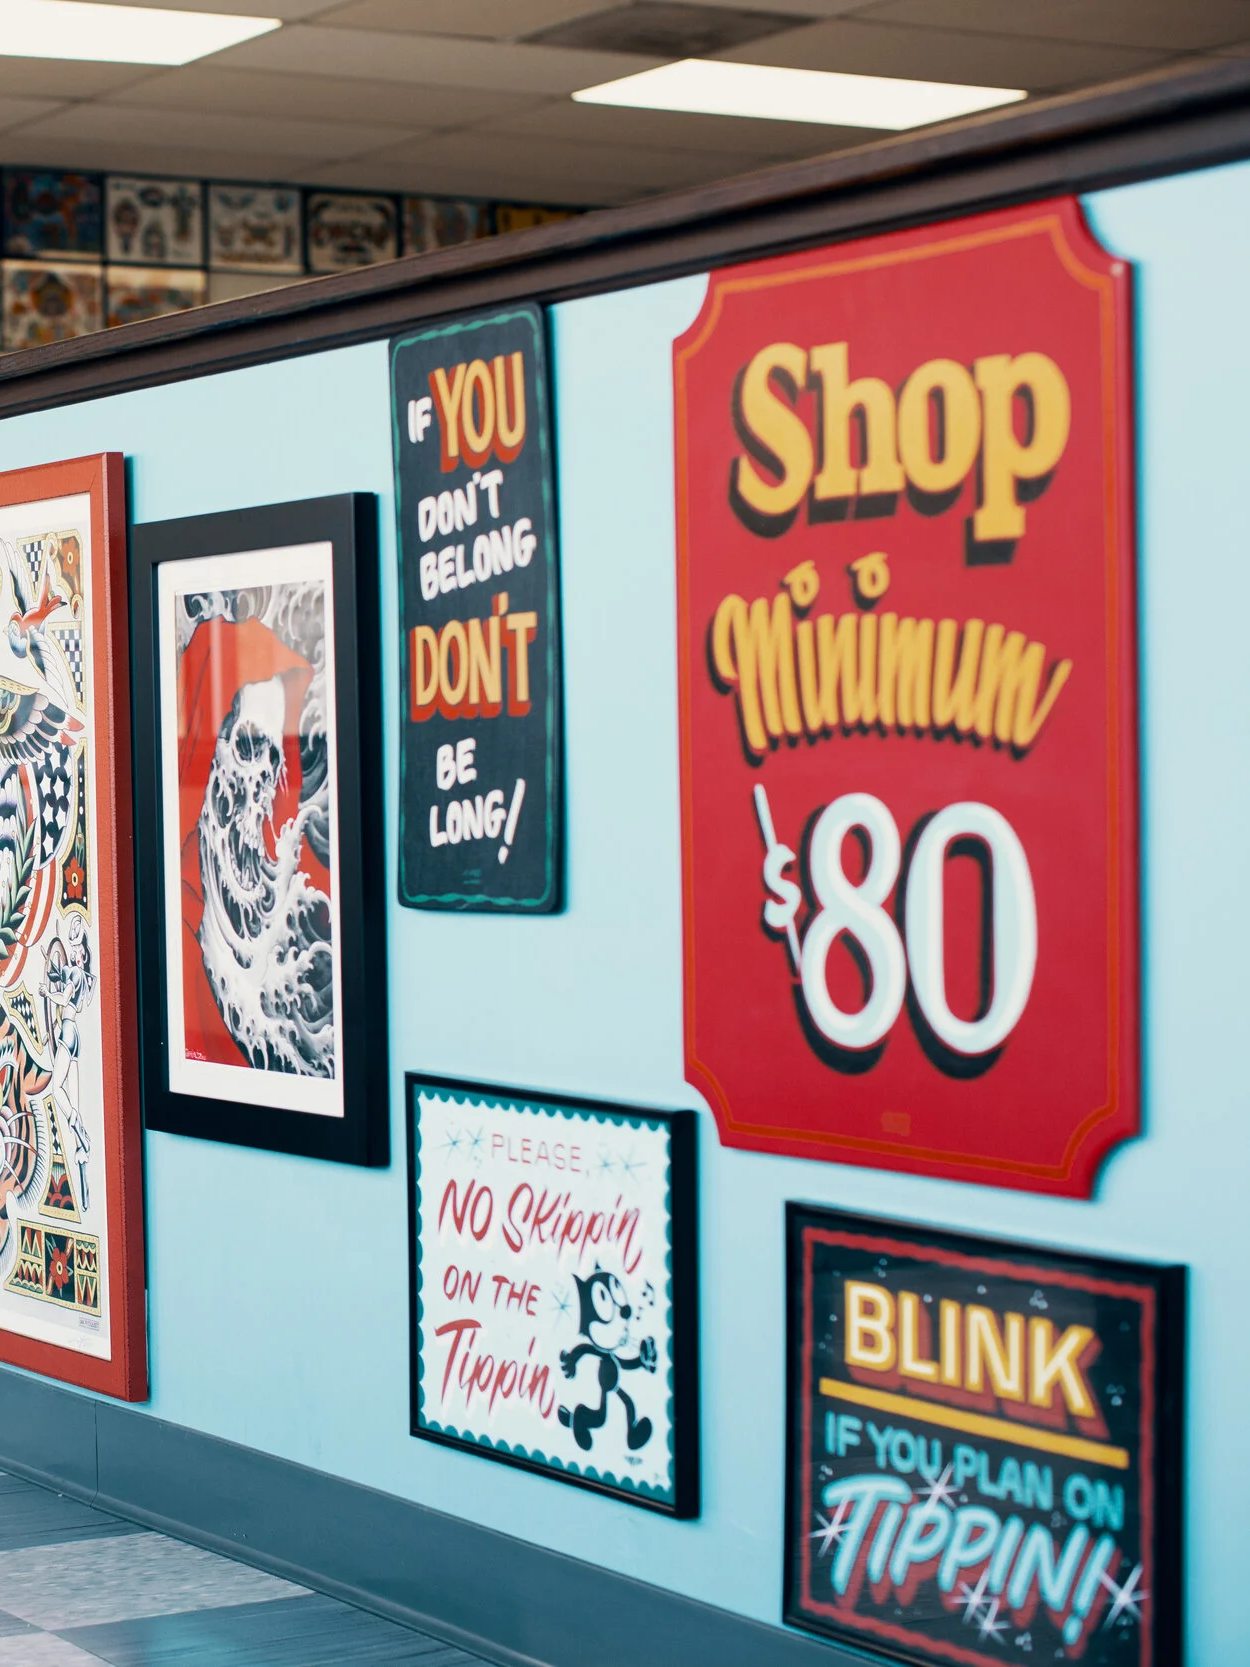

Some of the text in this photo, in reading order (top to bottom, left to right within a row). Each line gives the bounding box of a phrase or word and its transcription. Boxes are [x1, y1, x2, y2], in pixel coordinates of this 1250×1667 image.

[408, 351, 525, 464] IF YOU
[734, 342, 1071, 550] Shop
[418, 470, 504, 543] DON'T
[419, 518, 536, 600] BELONG
[412, 592, 537, 712] DON'T
[711, 552, 1072, 752] Minimum
[436, 737, 477, 791] BE
[429, 778, 526, 864] LONG!
[753, 783, 1039, 1056] $80
[438, 1178, 494, 1242] NO
[443, 1265, 542, 1316] ON THE
[434, 1319, 556, 1420] Tippin
[844, 1279, 1097, 1419] BLINK
[825, 1410, 1125, 1532] IF YOU PLAN ON
[822, 1474, 1117, 1646] TIPPIN!
